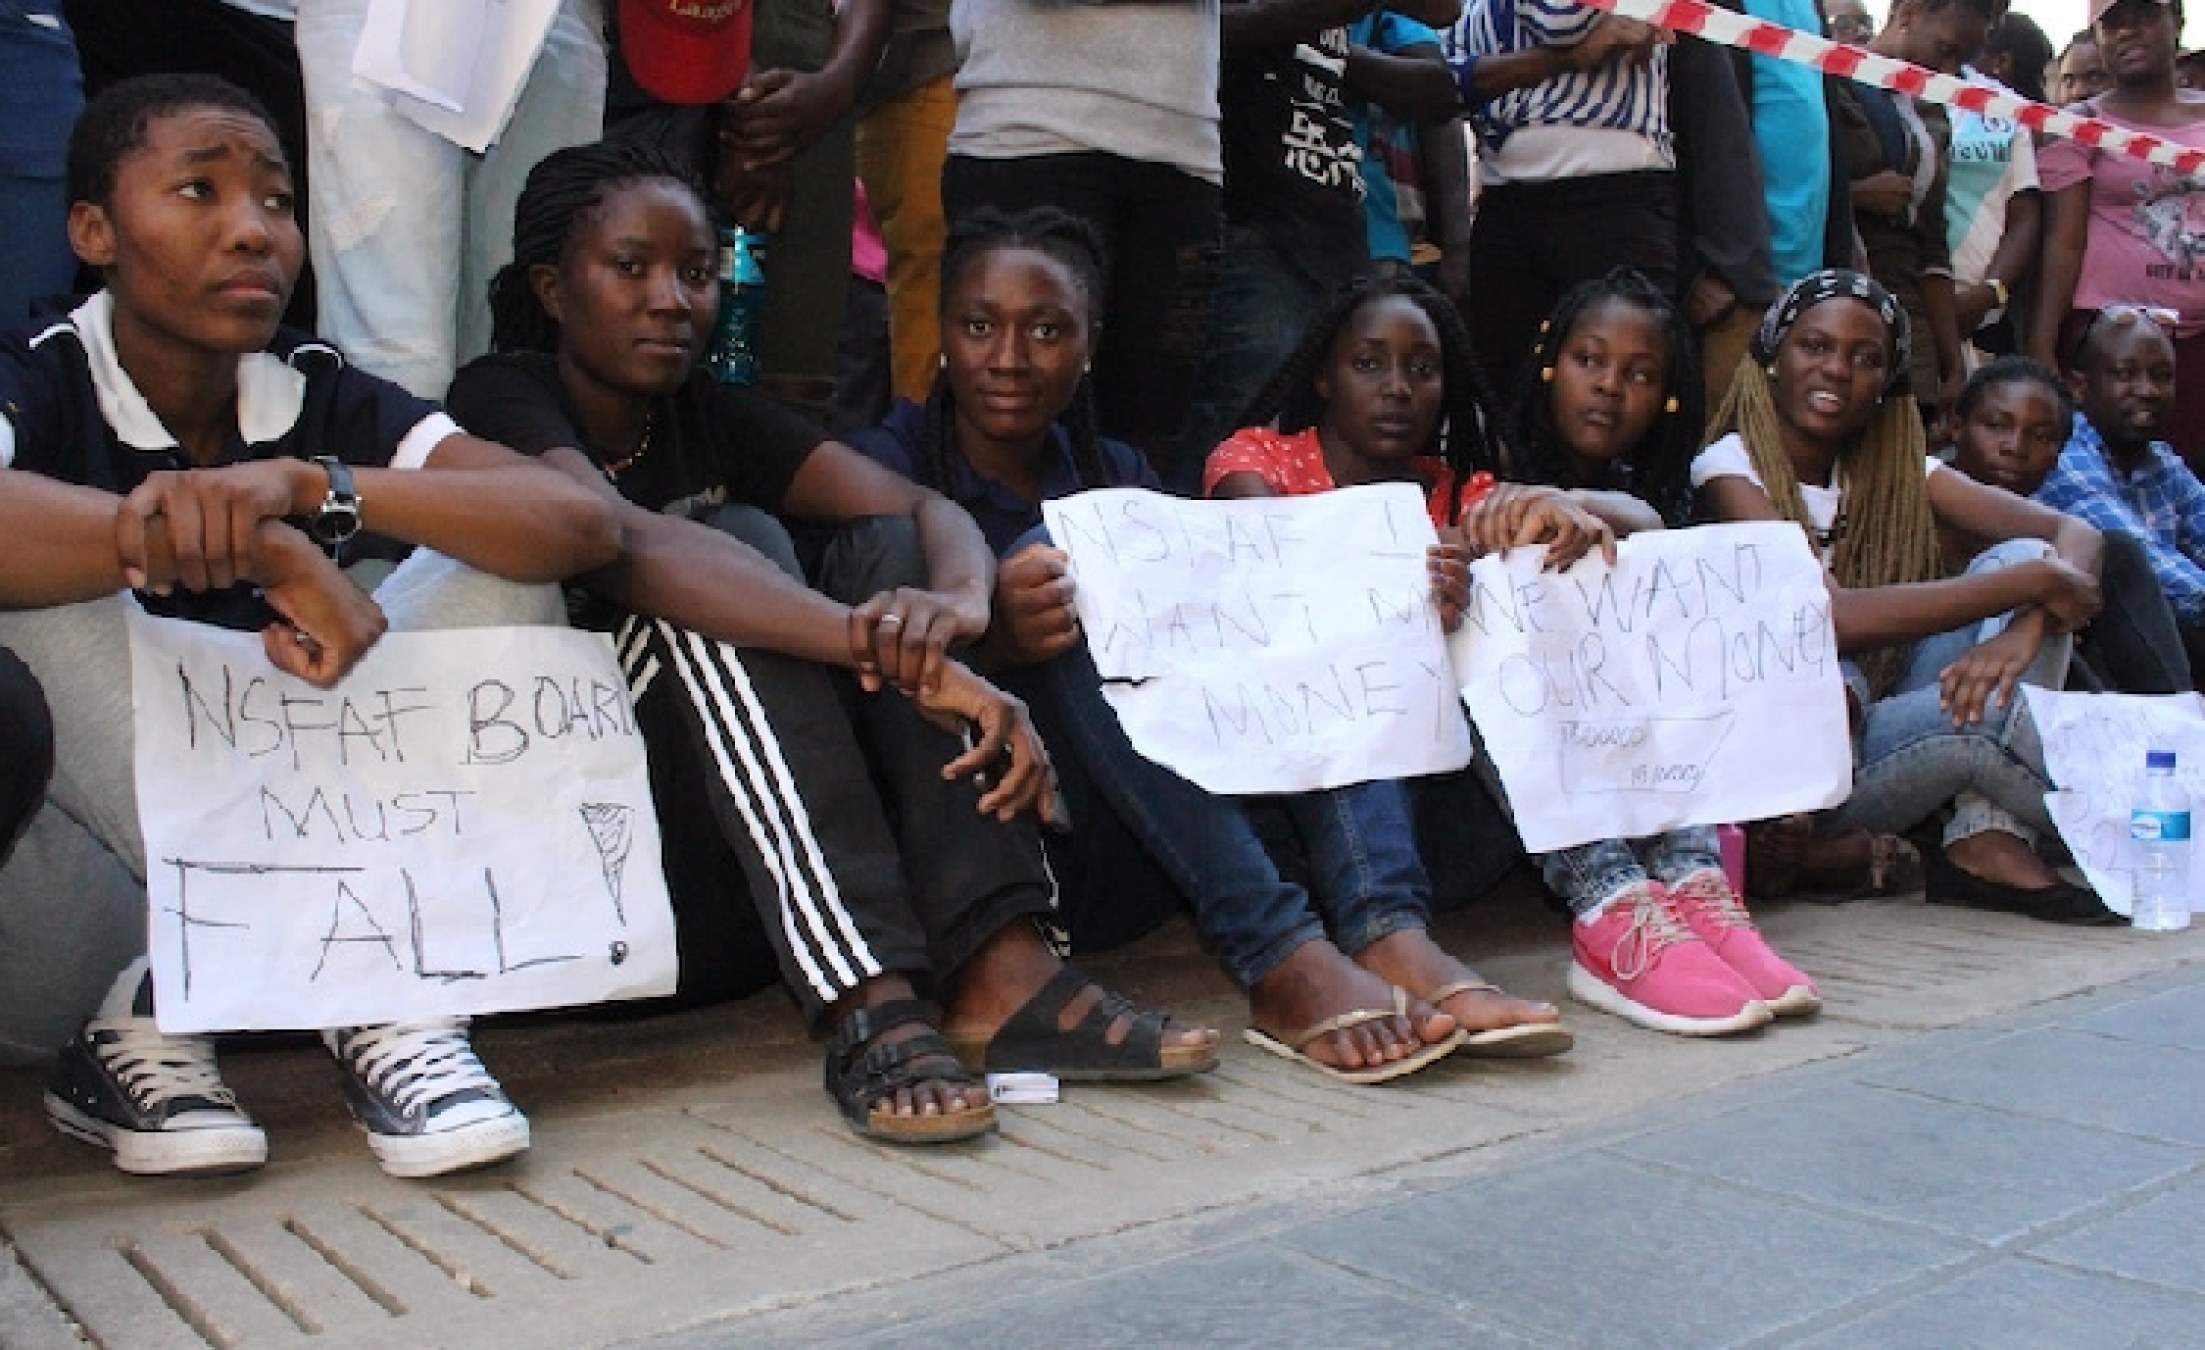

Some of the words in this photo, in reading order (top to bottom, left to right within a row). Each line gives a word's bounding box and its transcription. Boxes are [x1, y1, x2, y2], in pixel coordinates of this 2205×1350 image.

[1576, 543, 1761, 633] WANT
[1203, 660, 1446, 745] MONEY
[1500, 632, 1630, 717] OUR
[1646, 601, 1829, 700] MONEY
[178, 656, 438, 770] NSFAF
[260, 785, 476, 843] MUST
